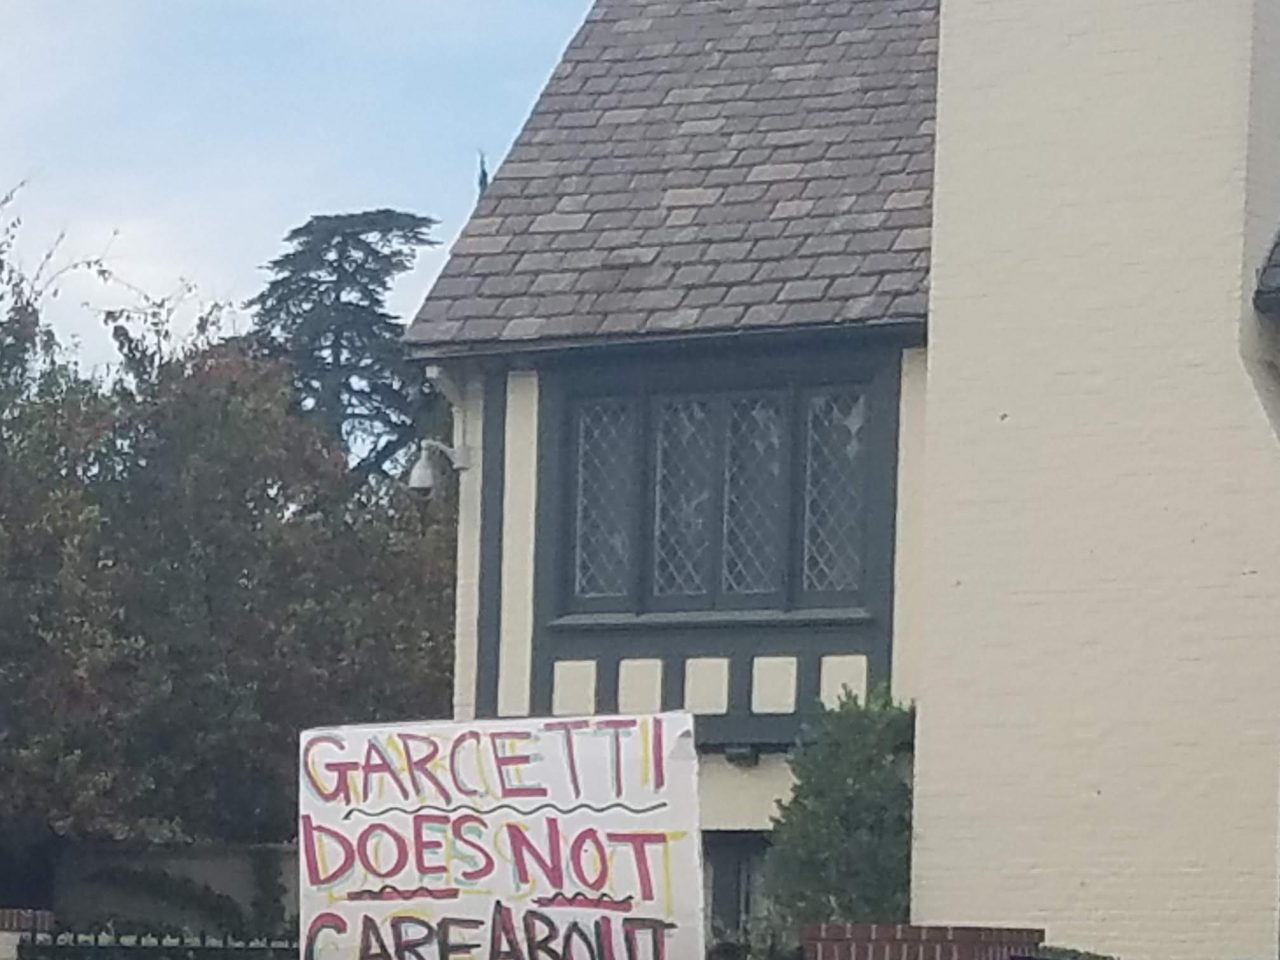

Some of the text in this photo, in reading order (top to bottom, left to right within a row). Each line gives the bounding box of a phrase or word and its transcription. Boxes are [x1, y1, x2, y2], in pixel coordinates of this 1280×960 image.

[304, 717, 666, 805] GARCETTI
[301, 814, 669, 902] DOES NOT
